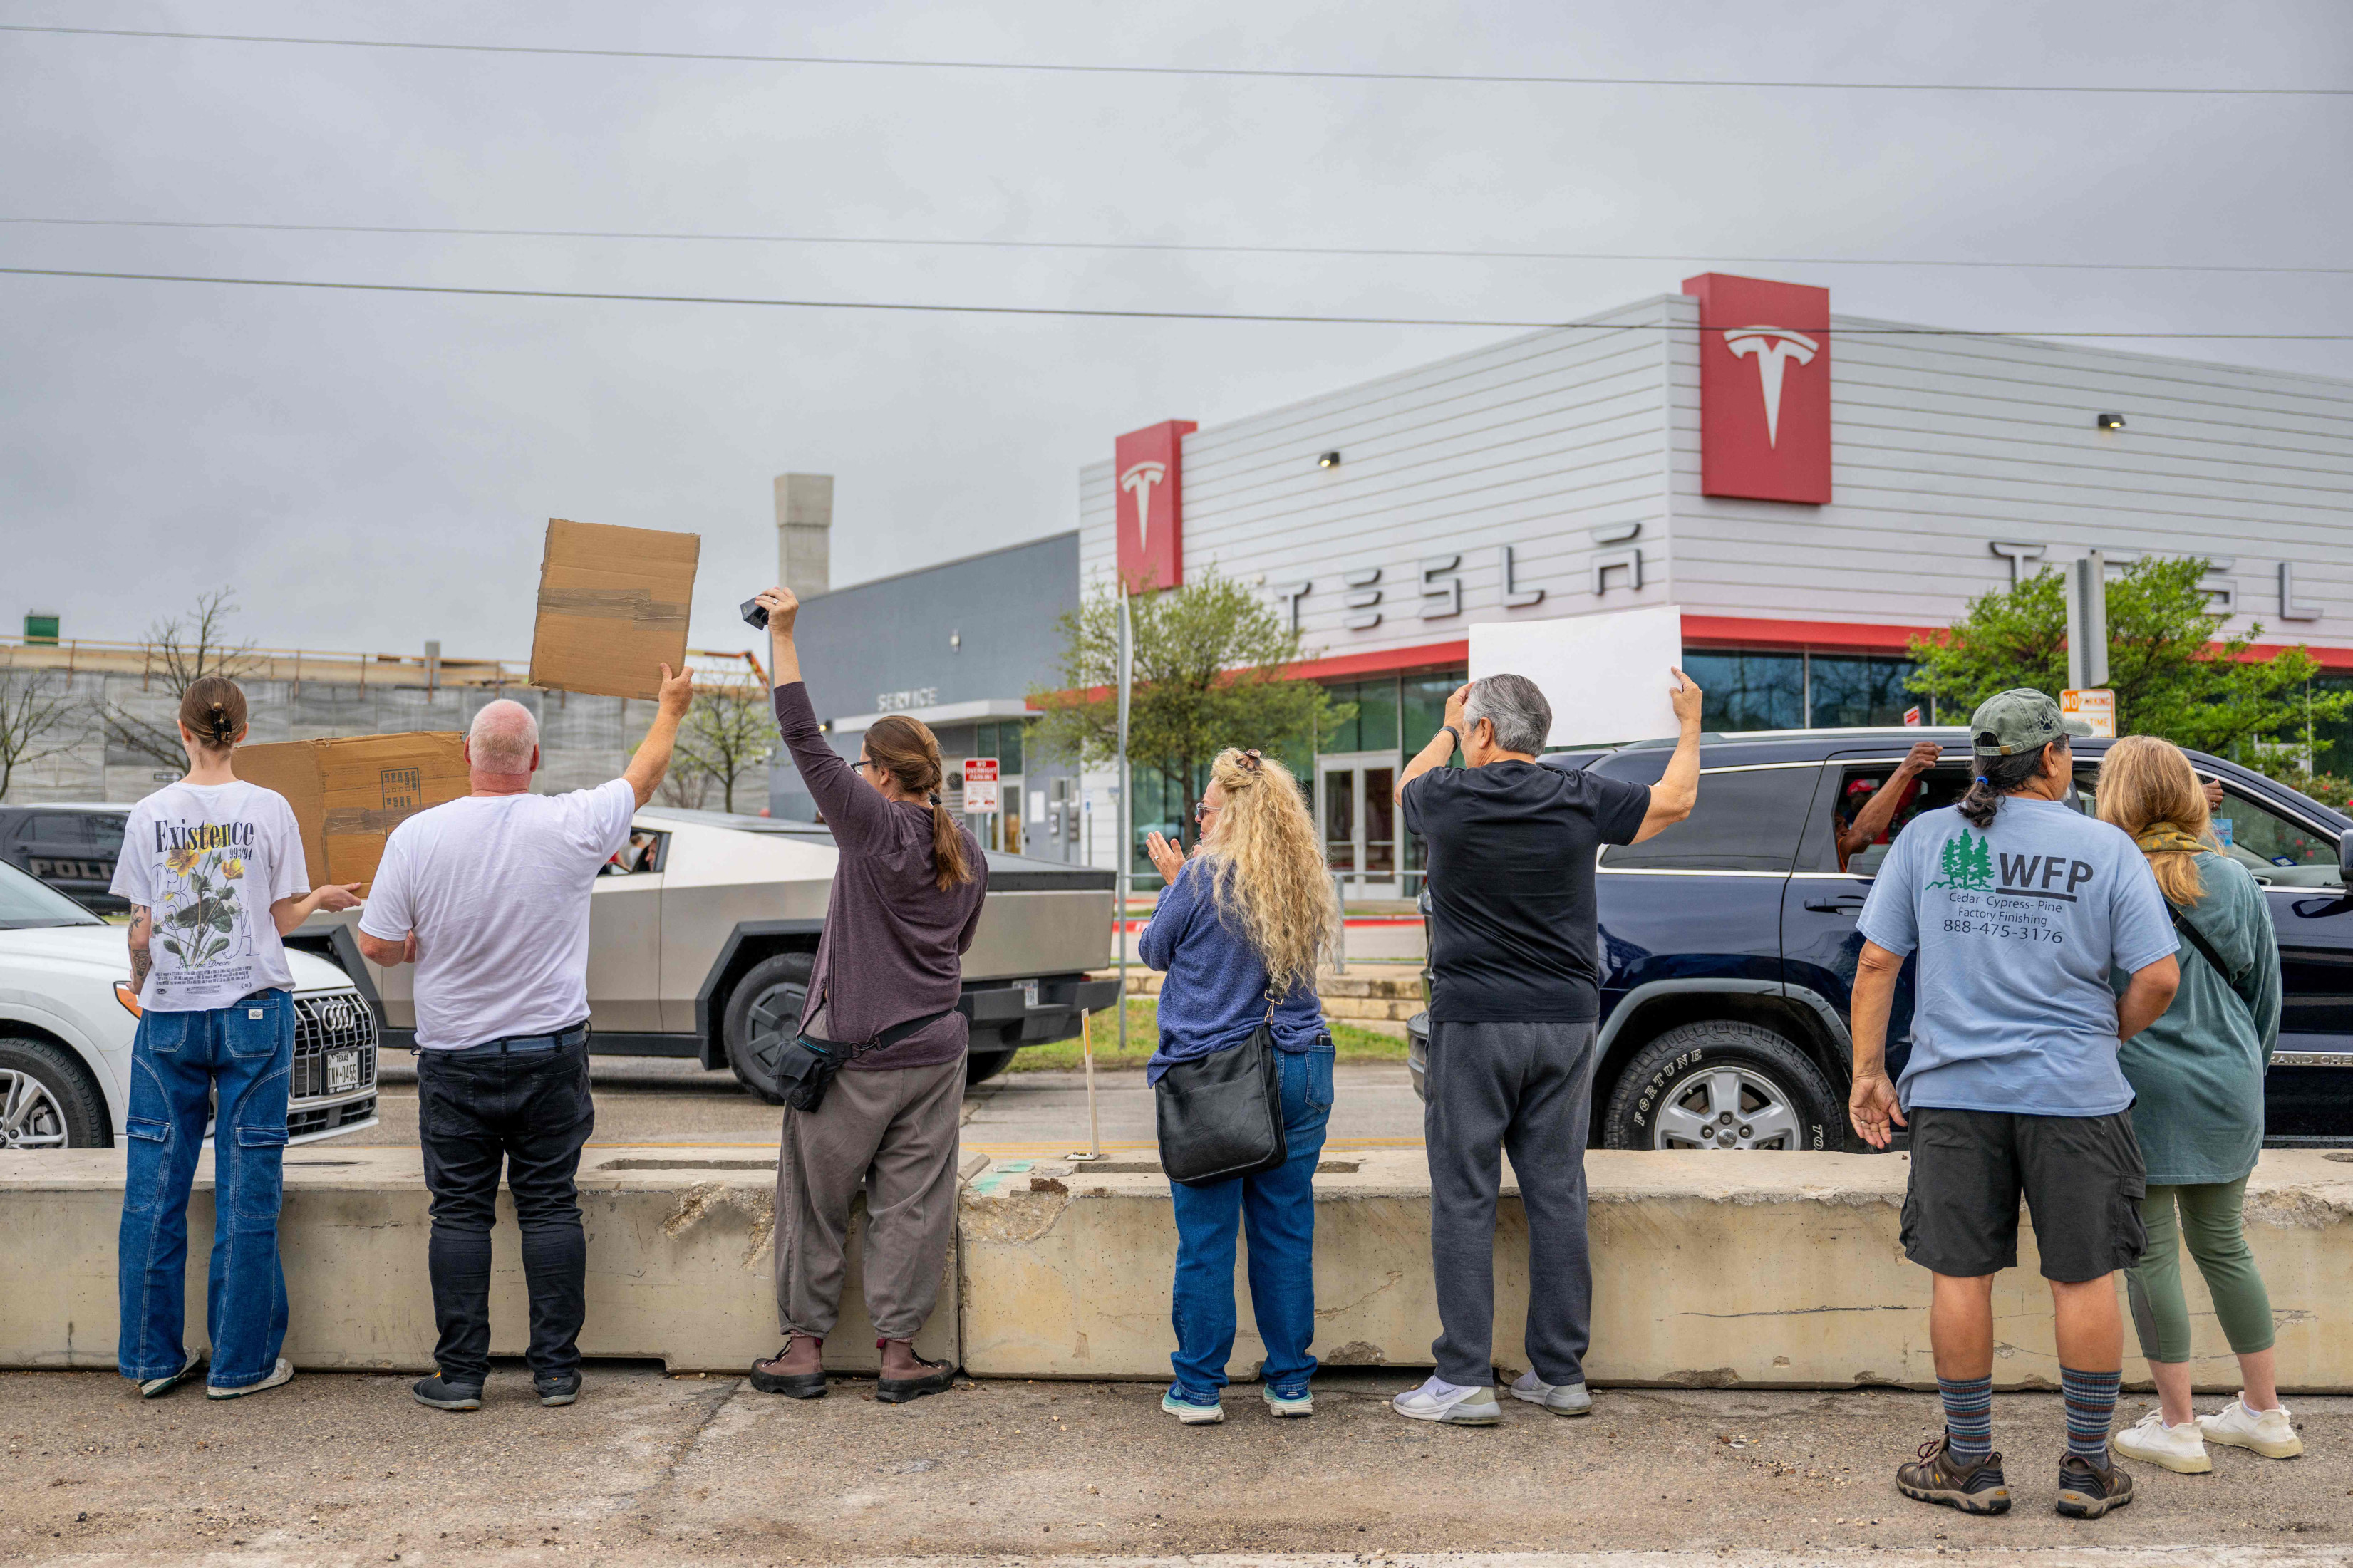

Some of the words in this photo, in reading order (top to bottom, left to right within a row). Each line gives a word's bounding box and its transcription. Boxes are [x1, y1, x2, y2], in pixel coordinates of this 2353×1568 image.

[1274, 522, 1642, 635] TESLA
[2064, 694, 2077, 710] NO
[2079, 697, 2111, 707] PARKING
[2090, 717, 2109, 727] TIME
[154, 819, 254, 853] Existence
[29, 858, 115, 881] POLI
[1999, 853, 2094, 893] WFP
[1949, 892, 1984, 903] Cedar-
[1987, 895, 2034, 910] Cypress-
[2038, 900, 2062, 913] Pine
[1958, 907, 1996, 922] Factory
[1998, 911, 2047, 927] Finishing
[1943, 919, 2063, 944] 888-475-3176
[336, 1054, 349, 1062] TEXAS
[2270, 1055, 2314, 1064] RAND
[1633, 1049, 1702, 1127] FORTUNE
[1812, 1124, 1824, 1151] TO
